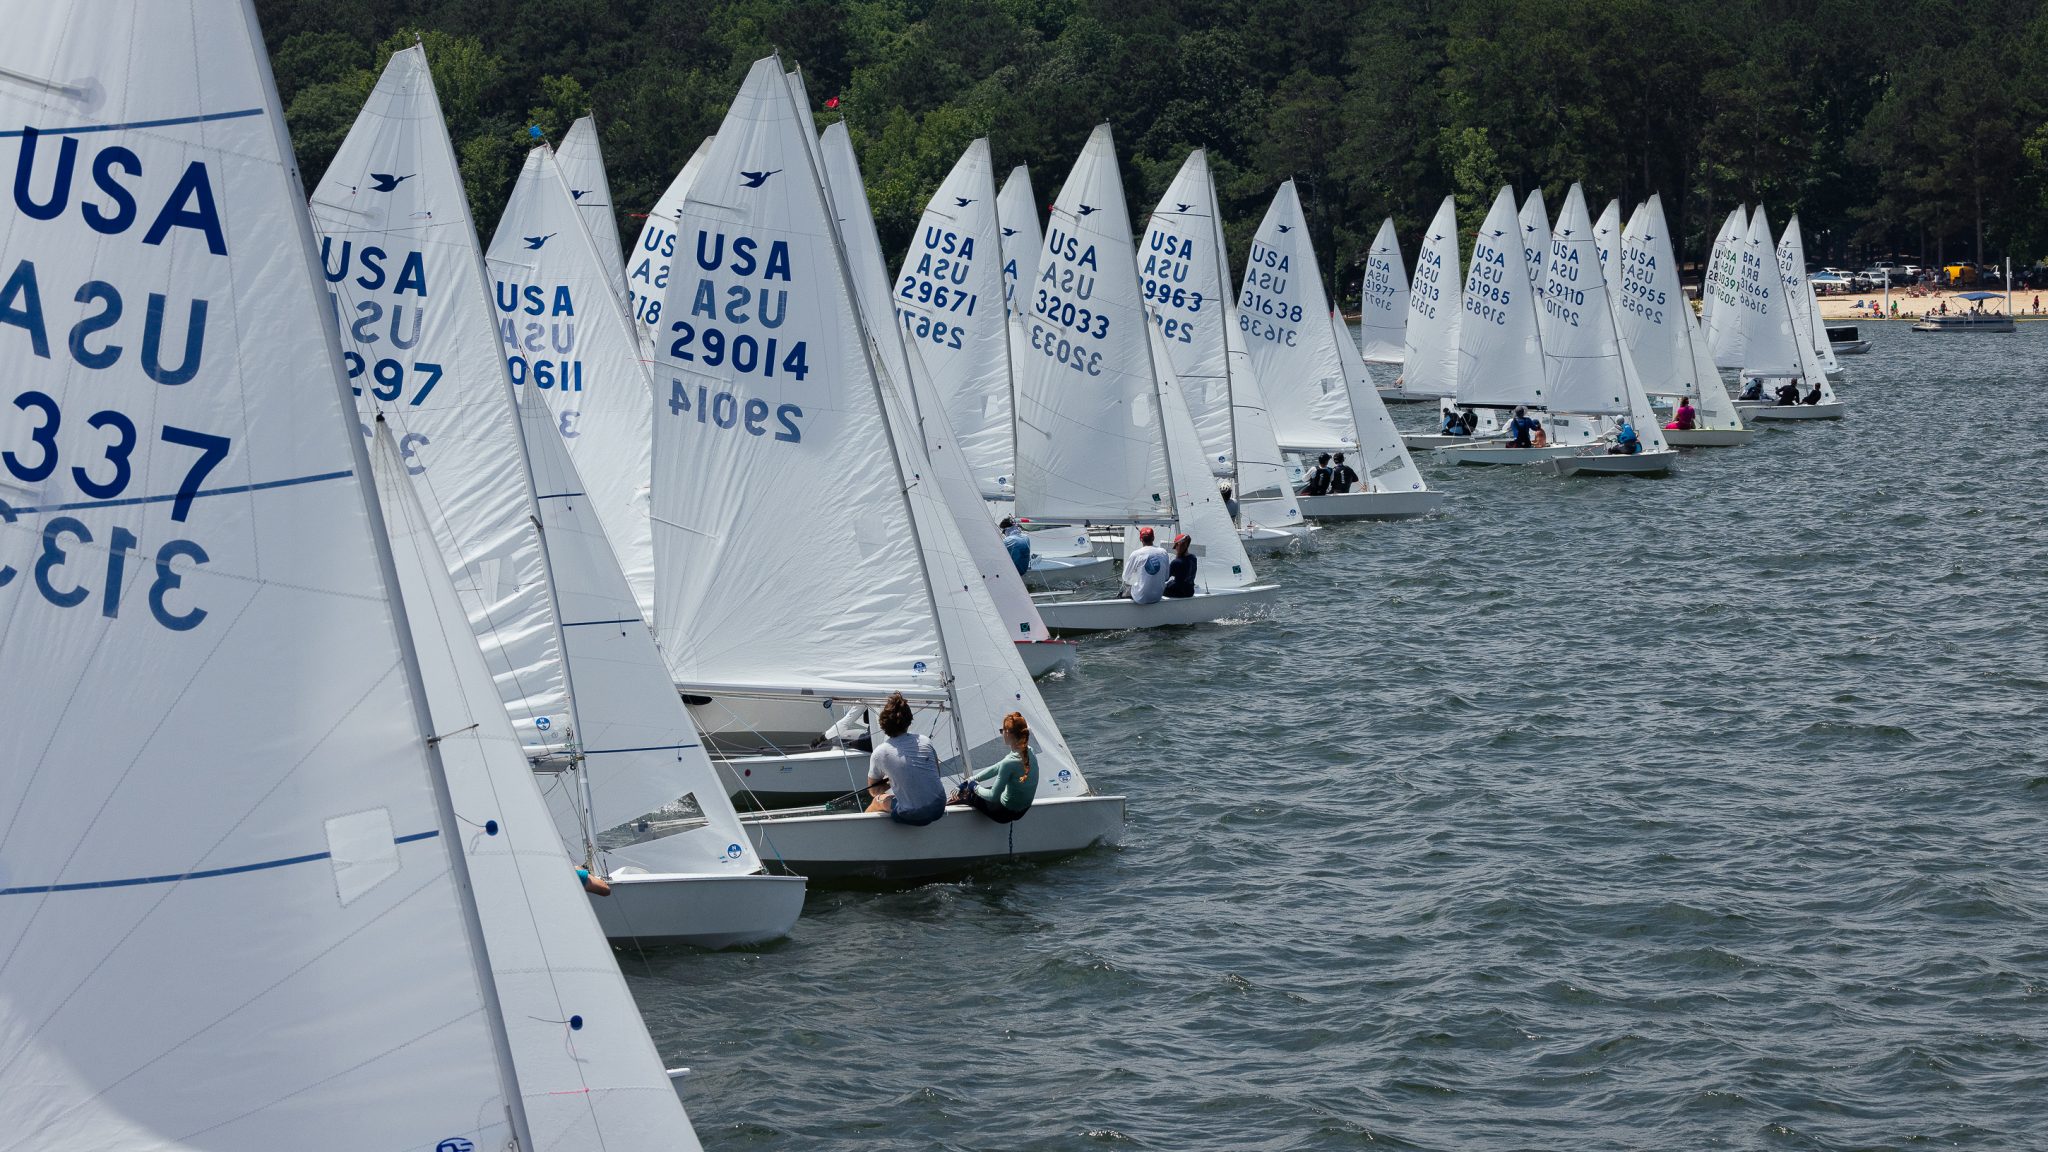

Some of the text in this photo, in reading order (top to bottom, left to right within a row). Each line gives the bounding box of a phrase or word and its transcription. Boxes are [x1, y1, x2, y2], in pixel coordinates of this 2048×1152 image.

[13, 125, 228, 256] USA
[697, 230, 791, 281] USA
[925, 226, 974, 260] USA
[1050, 228, 1097, 272] USA
[1151, 230, 1192, 260] USA
[1477, 244, 1505, 268] USA
[1552, 240, 1579, 264] USA
[1777, 247, 1793, 261] USA
[321, 236, 427, 297] USA
[1252, 245, 1289, 273] USA
[1369, 257, 1390, 273] USA
[1421, 246, 1441, 269] USA
[1630, 247, 1656, 270] USA
[1743, 251, 1760, 269] BRA
[497, 281, 574, 316] USA
[901, 276, 977, 316] 29671
[1366, 279, 1395, 297] 31977
[1413, 277, 1440, 301] 31313
[1469, 278, 1510, 305] 31985
[1548, 279, 1584, 306] 29110
[1623, 278, 1666, 305] 29955
[1740, 277, 1769, 299] 31666
[1036, 289, 1110, 339] 32033
[1243, 291, 1302, 323] 31638
[671, 321, 808, 381] 29014
[508, 356, 582, 391] 0611
[2, 391, 231, 522] 337
